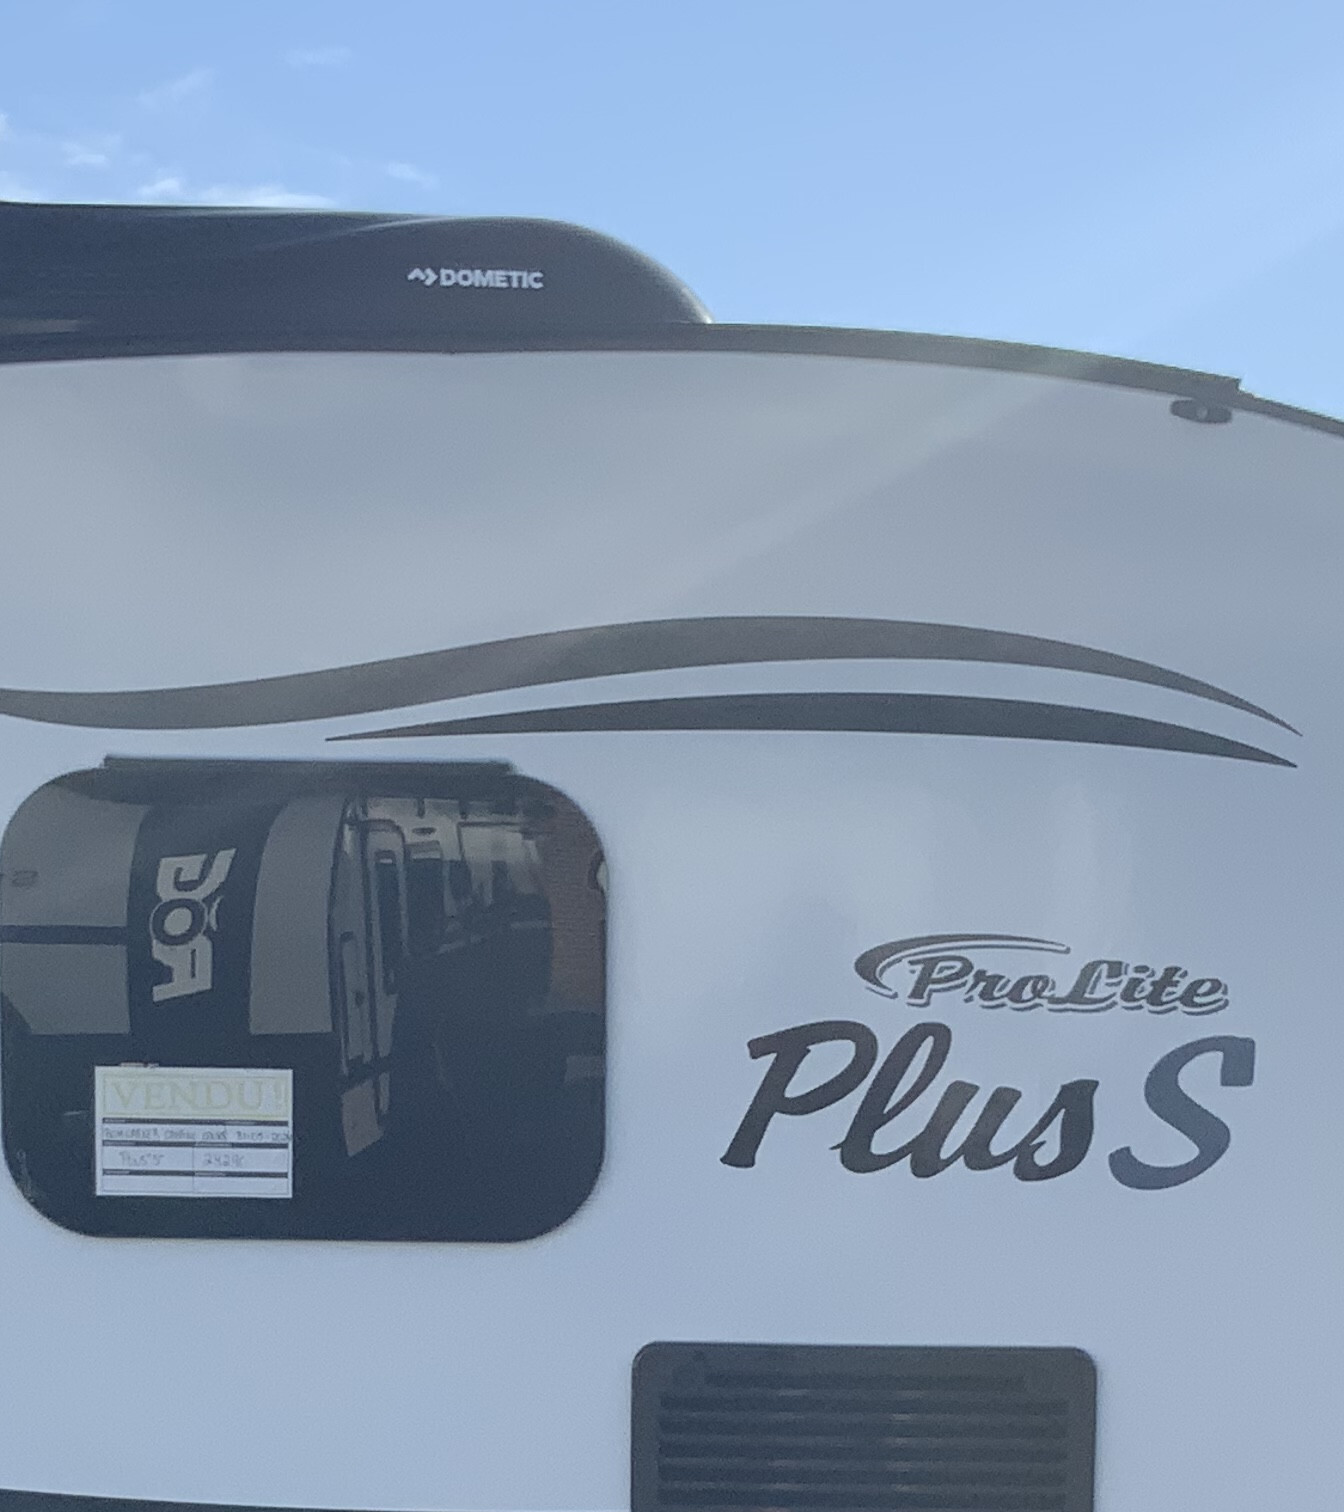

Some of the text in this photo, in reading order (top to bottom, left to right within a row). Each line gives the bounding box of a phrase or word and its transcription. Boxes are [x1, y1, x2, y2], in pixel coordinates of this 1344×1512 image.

[439, 268, 544, 289] DOMETIC
[903, 953, 1231, 1015] ProLite
[718, 1019, 1256, 1191] Plus S
